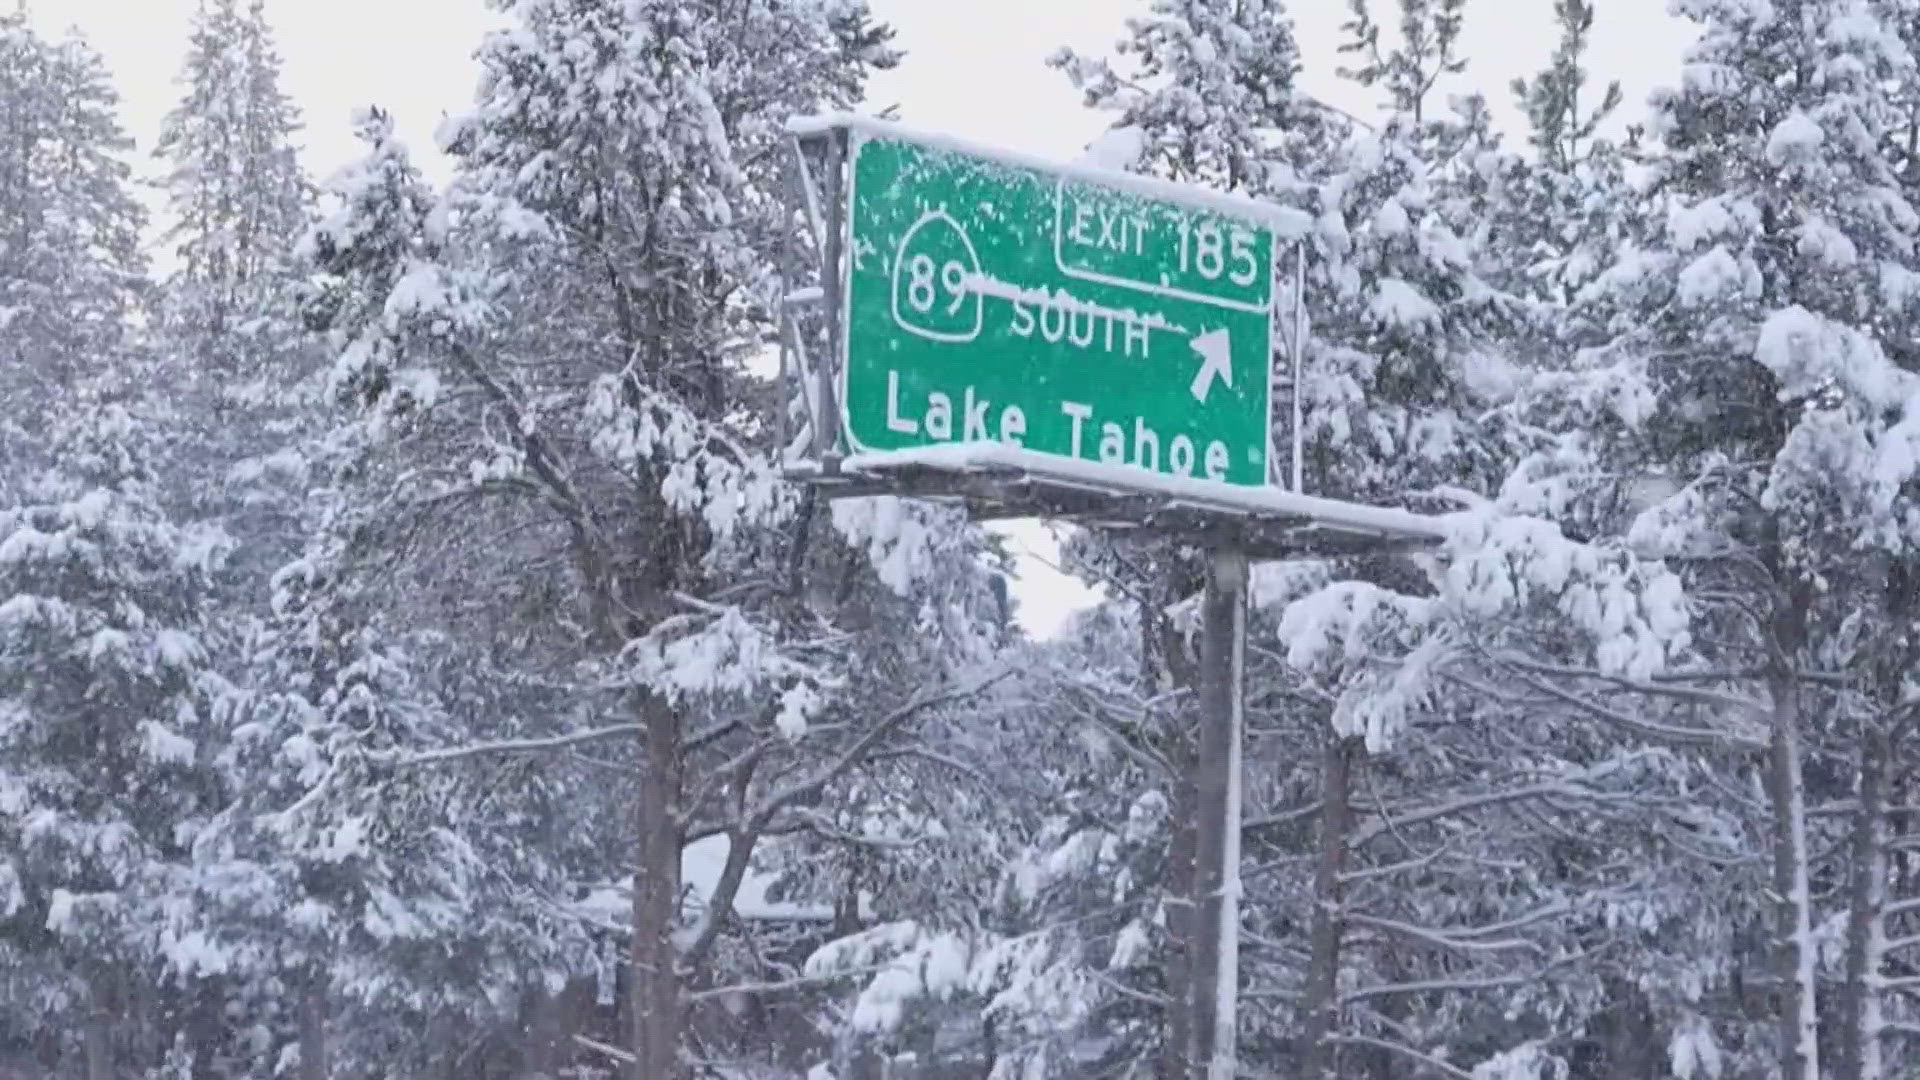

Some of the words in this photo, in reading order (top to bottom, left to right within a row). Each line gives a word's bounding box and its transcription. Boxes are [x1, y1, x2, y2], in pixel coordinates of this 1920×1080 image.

[1074, 201, 1147, 256] EXIT
[1178, 218, 1257, 286] 185
[908, 255, 967, 316] 89
[1010, 294, 1149, 359] SOUTH
[886, 370, 1026, 448] Lake
[1061, 401, 1230, 482] Tahoe
